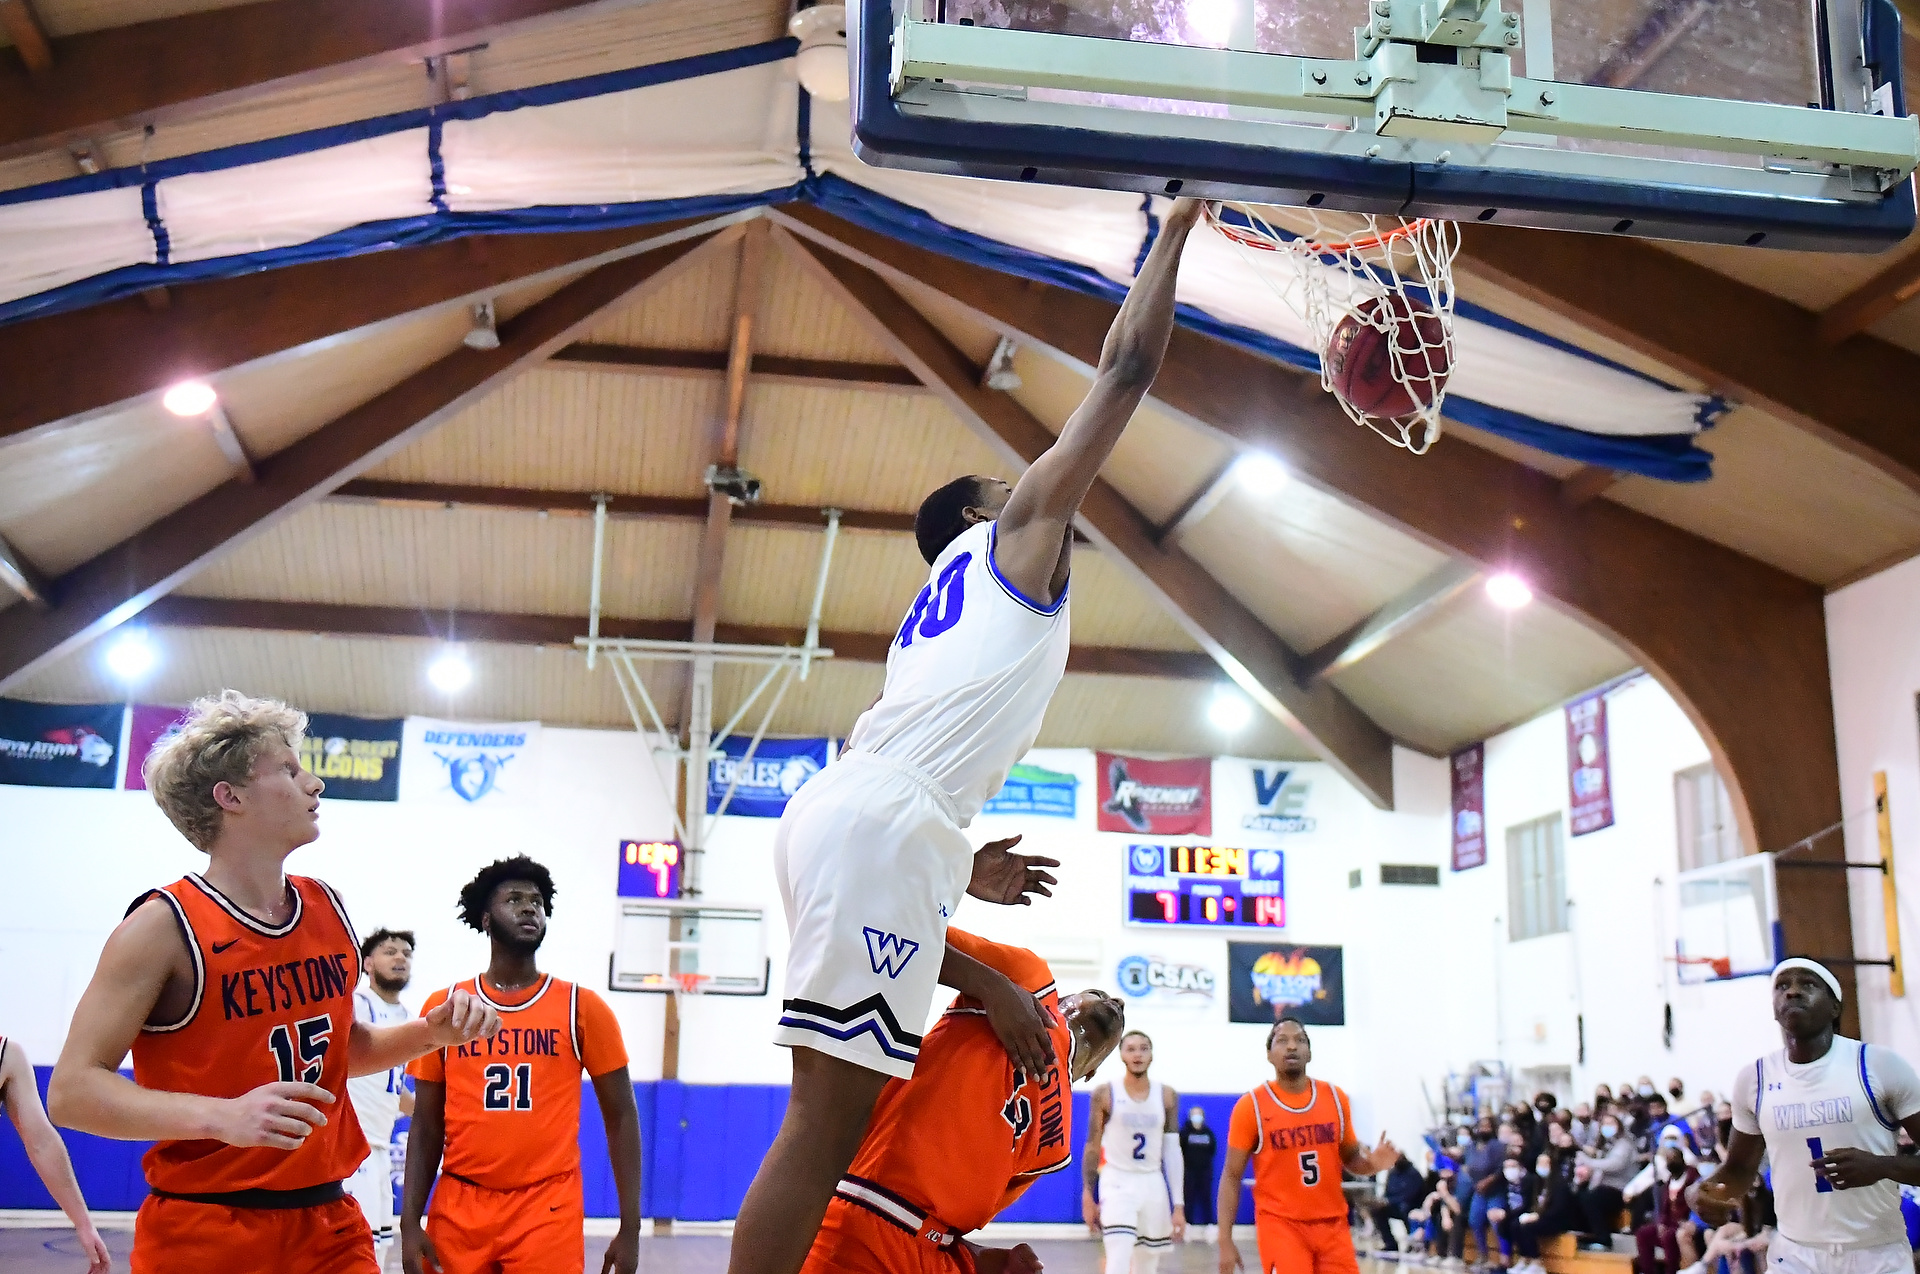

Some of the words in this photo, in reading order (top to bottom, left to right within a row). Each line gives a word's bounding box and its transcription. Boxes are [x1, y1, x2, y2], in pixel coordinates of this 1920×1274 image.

[424, 731, 526, 747] DEFENDERS
[300, 752, 383, 780] ALCONS
[647, 863, 670, 897] 7
[1155, 890, 1178, 923] 7
[1205, 897, 1218, 922] 1
[1255, 896, 1286, 927] 14
[862, 926, 920, 980] W
[1147, 961, 1215, 992] CSAC
[268, 1013, 333, 1084] 15
[483, 1062, 533, 1111] 21
[1035, 1066, 1065, 1157] STONE
[1772, 1096, 1853, 1131] WILSON
[1132, 1132, 1147, 1160] 2
[1269, 1121, 1335, 1151] KEYSTONE
[1298, 1150, 1320, 1188] 5
[1805, 1136, 1834, 1193] 1
